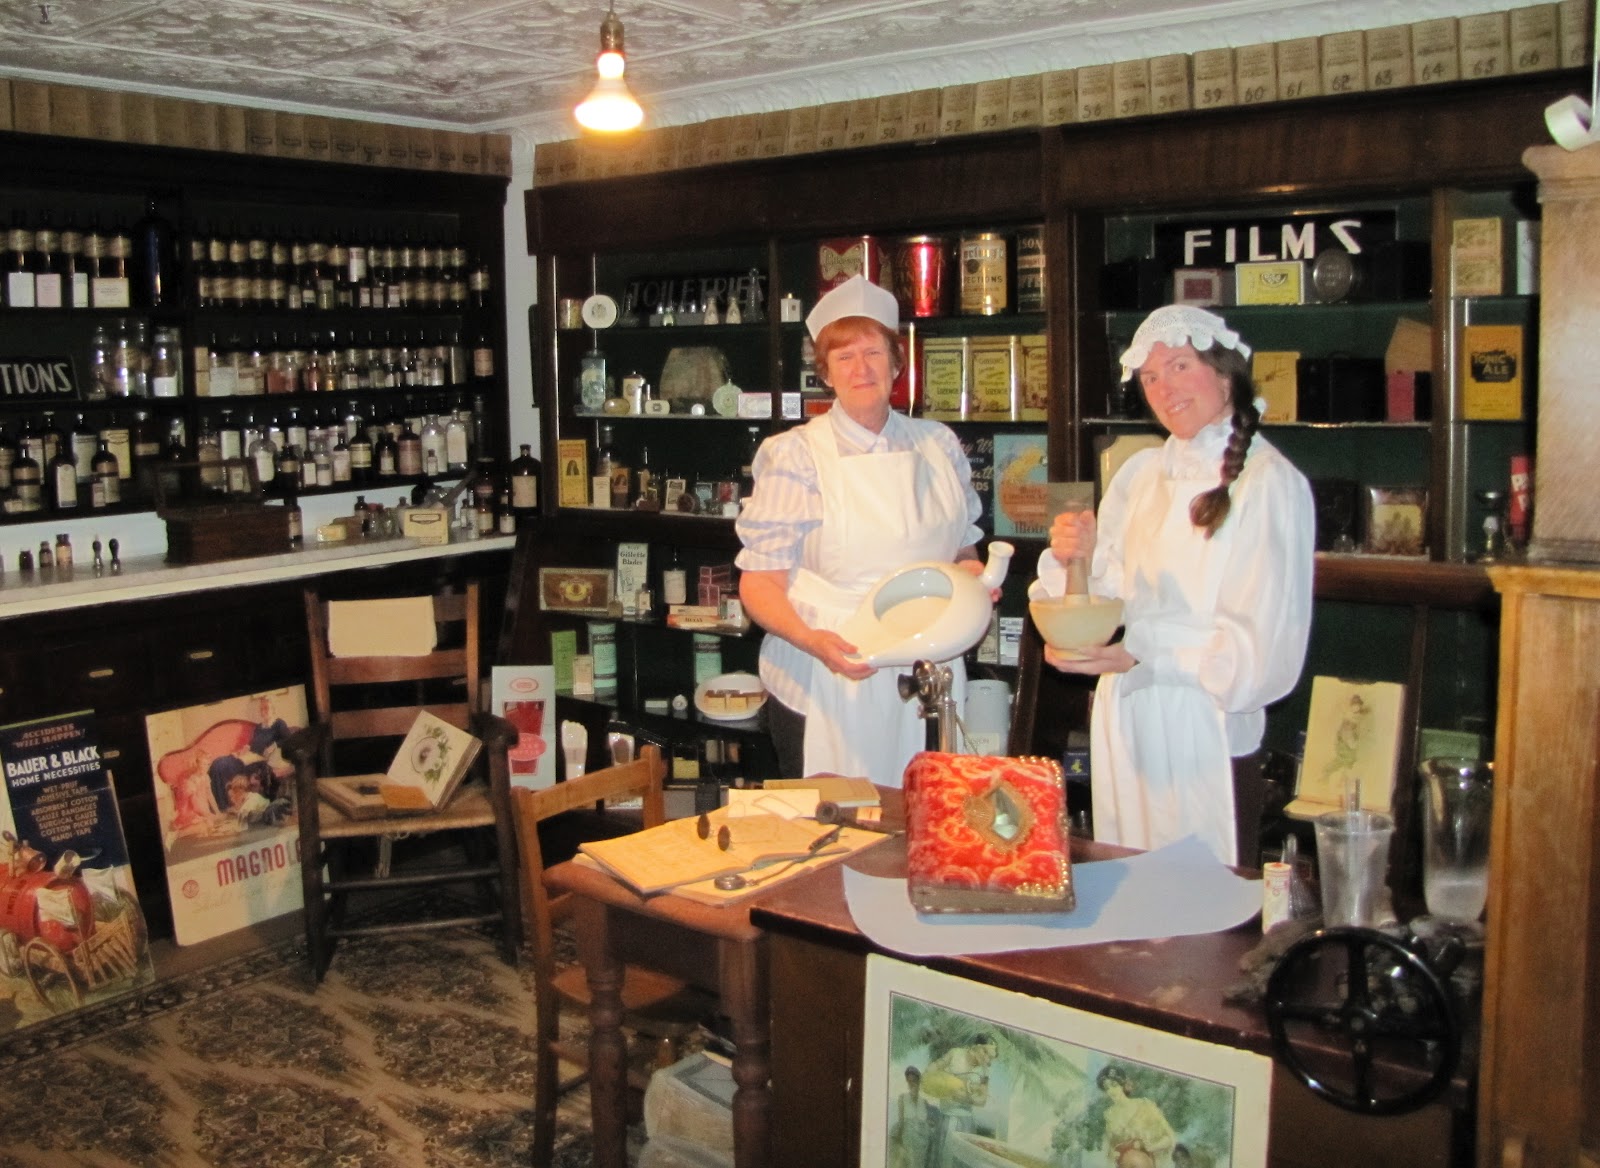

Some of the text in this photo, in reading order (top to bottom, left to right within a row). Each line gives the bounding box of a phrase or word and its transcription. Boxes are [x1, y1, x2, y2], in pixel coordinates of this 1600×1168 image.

[1422, 65, 1444, 81] 64
[1473, 57, 1496, 75] 65
[1332, 75, 1350, 91] 62
[1375, 69, 1393, 86] 63
[1204, 88, 1222, 103] 59
[1245, 87, 1265, 103] 60
[1184, 220, 1362, 265] FILMS
[22, 723, 75, 739] ACCIDENTS
[6, 746, 101, 777] BAUER & BLACK
[11, 762, 101, 787] HOME NECESSITIES
[37, 786, 88, 804] ADHESIVE TAPE
[31, 796, 98, 816] ABSORBENT COTTON
[36, 802, 97, 822] GAUZE BANDAGES
[39, 810, 97, 829] SURGICAL GAUZE
[41, 825, 71, 837] COTTON
[217, 843, 301, 887] MAGNOL
